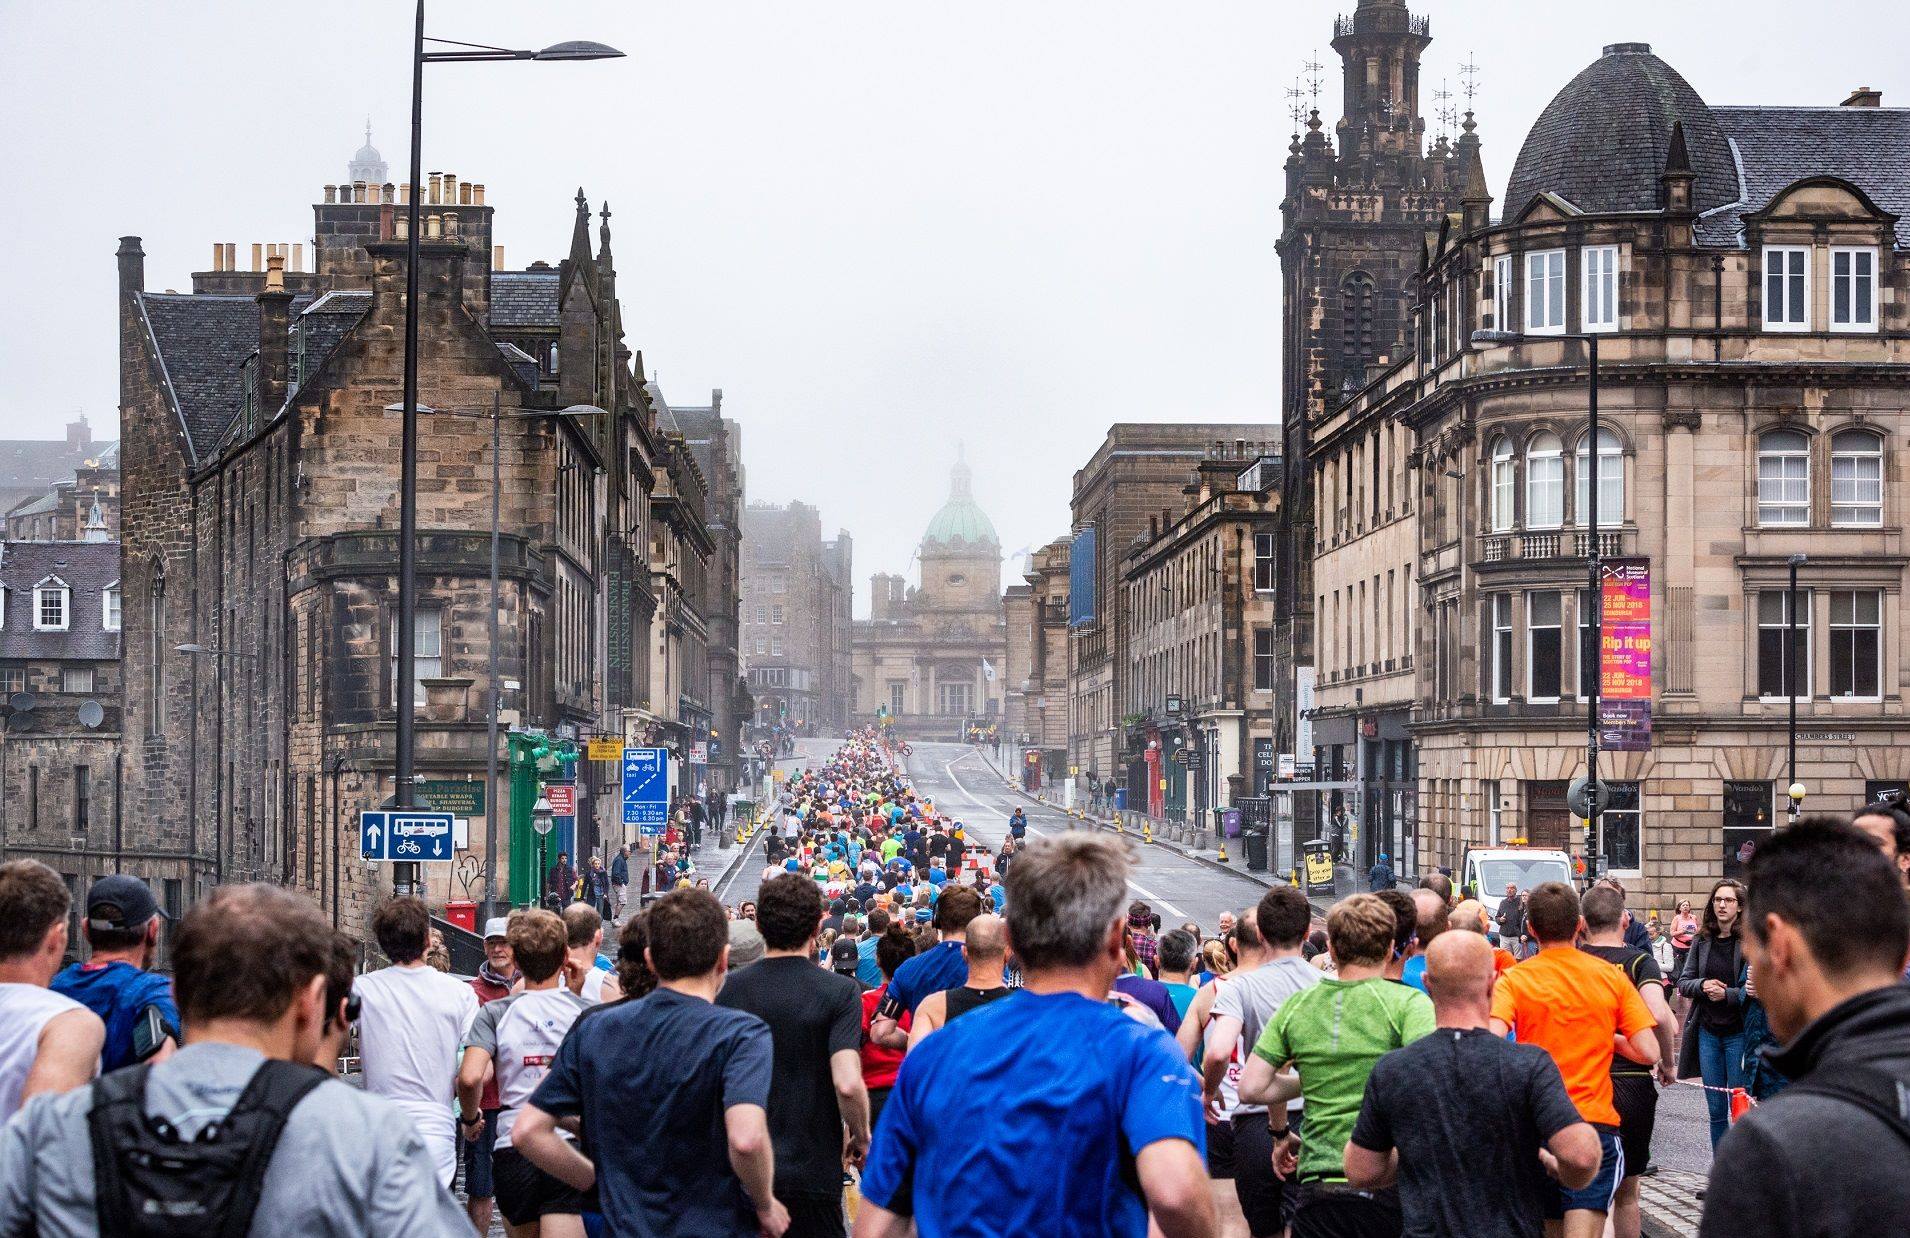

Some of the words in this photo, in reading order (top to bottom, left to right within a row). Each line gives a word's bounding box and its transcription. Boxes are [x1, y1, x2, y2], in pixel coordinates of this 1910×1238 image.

[609, 571, 620, 667] FRANKENSTEIN
[1612, 594, 1626, 602] JUN
[621, 580, 631, 672] FRANKENSTEIN
[1602, 635, 1622, 651] Rip
[1624, 636, 1634, 649] it
[1635, 638, 1651, 652] up
